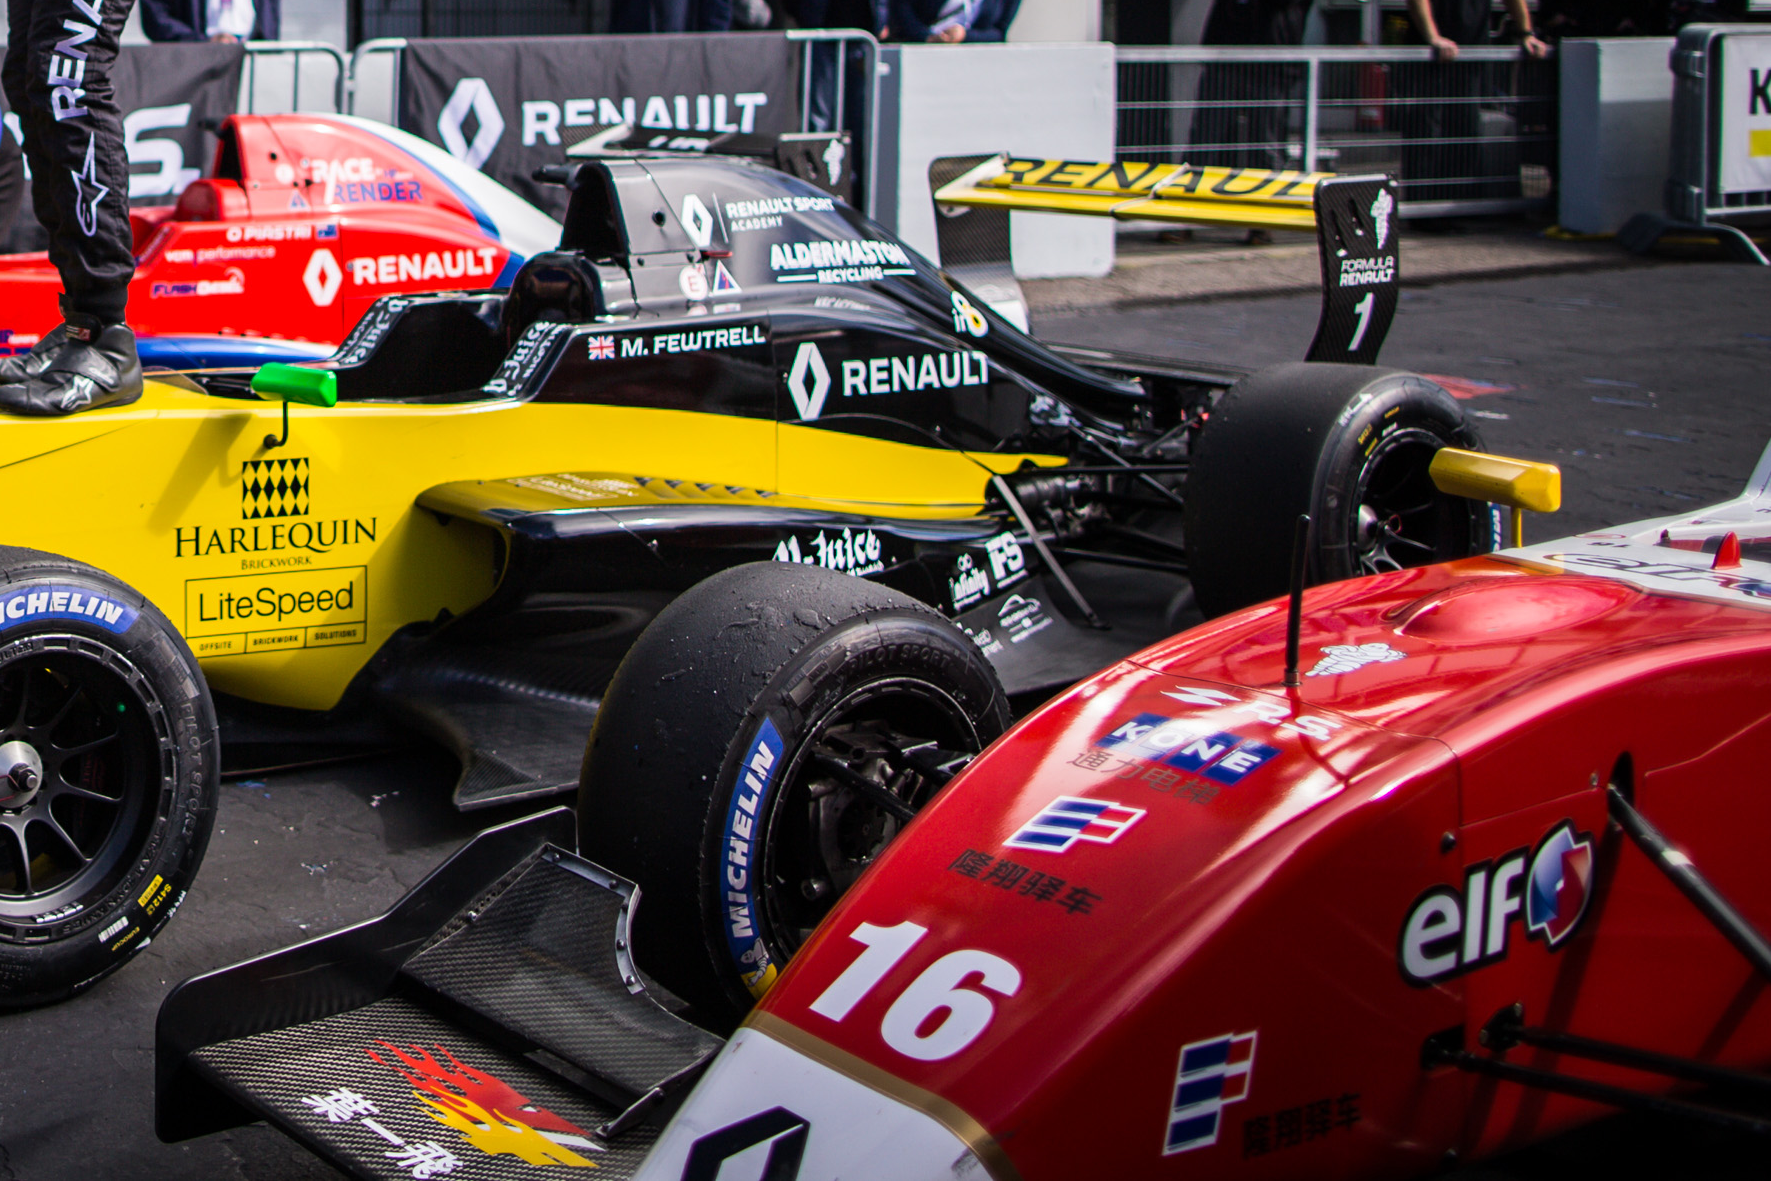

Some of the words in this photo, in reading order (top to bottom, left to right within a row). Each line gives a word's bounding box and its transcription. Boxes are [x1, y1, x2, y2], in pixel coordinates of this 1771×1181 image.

[521, 92, 768, 147] RENAULT
[335, 181, 424, 203] RENDER
[1001, 158, 1316, 198] RENAUL
[724, 197, 794, 219] RENAULT
[794, 196, 837, 213] SPORT
[730, 215, 784, 232] ACADEMY
[354, 247, 498, 286] RENAULT
[770, 239, 912, 271] ALDERMASTON
[1341, 256, 1395, 273] FORMULA
[816, 266, 885, 285] RECYCLING
[1339, 268, 1395, 287] RENAULT
[1347, 291, 1375, 352] 1
[620, 337, 649, 358] M.
[653, 325, 767, 356] FEWTRELL
[841, 350, 989, 397] RENAULT
[174, 517, 378, 558] HARLEQUIN
[199, 580, 354, 622] LiteSpeed
[199, 640, 233, 652] OFFSITE
[252, 634, 299, 646] BRICKWORK
[314, 629, 358, 641] SOLUTIONS
[1109, 719, 1264, 775] KONE
[1066, 749, 1221, 806] 通力电梯
[727, 740, 775, 939] MICHELIN
[947, 848, 1104, 915] 隆翔驿车
[1400, 853, 1525, 982] elf
[810, 918, 1022, 1062] 16
